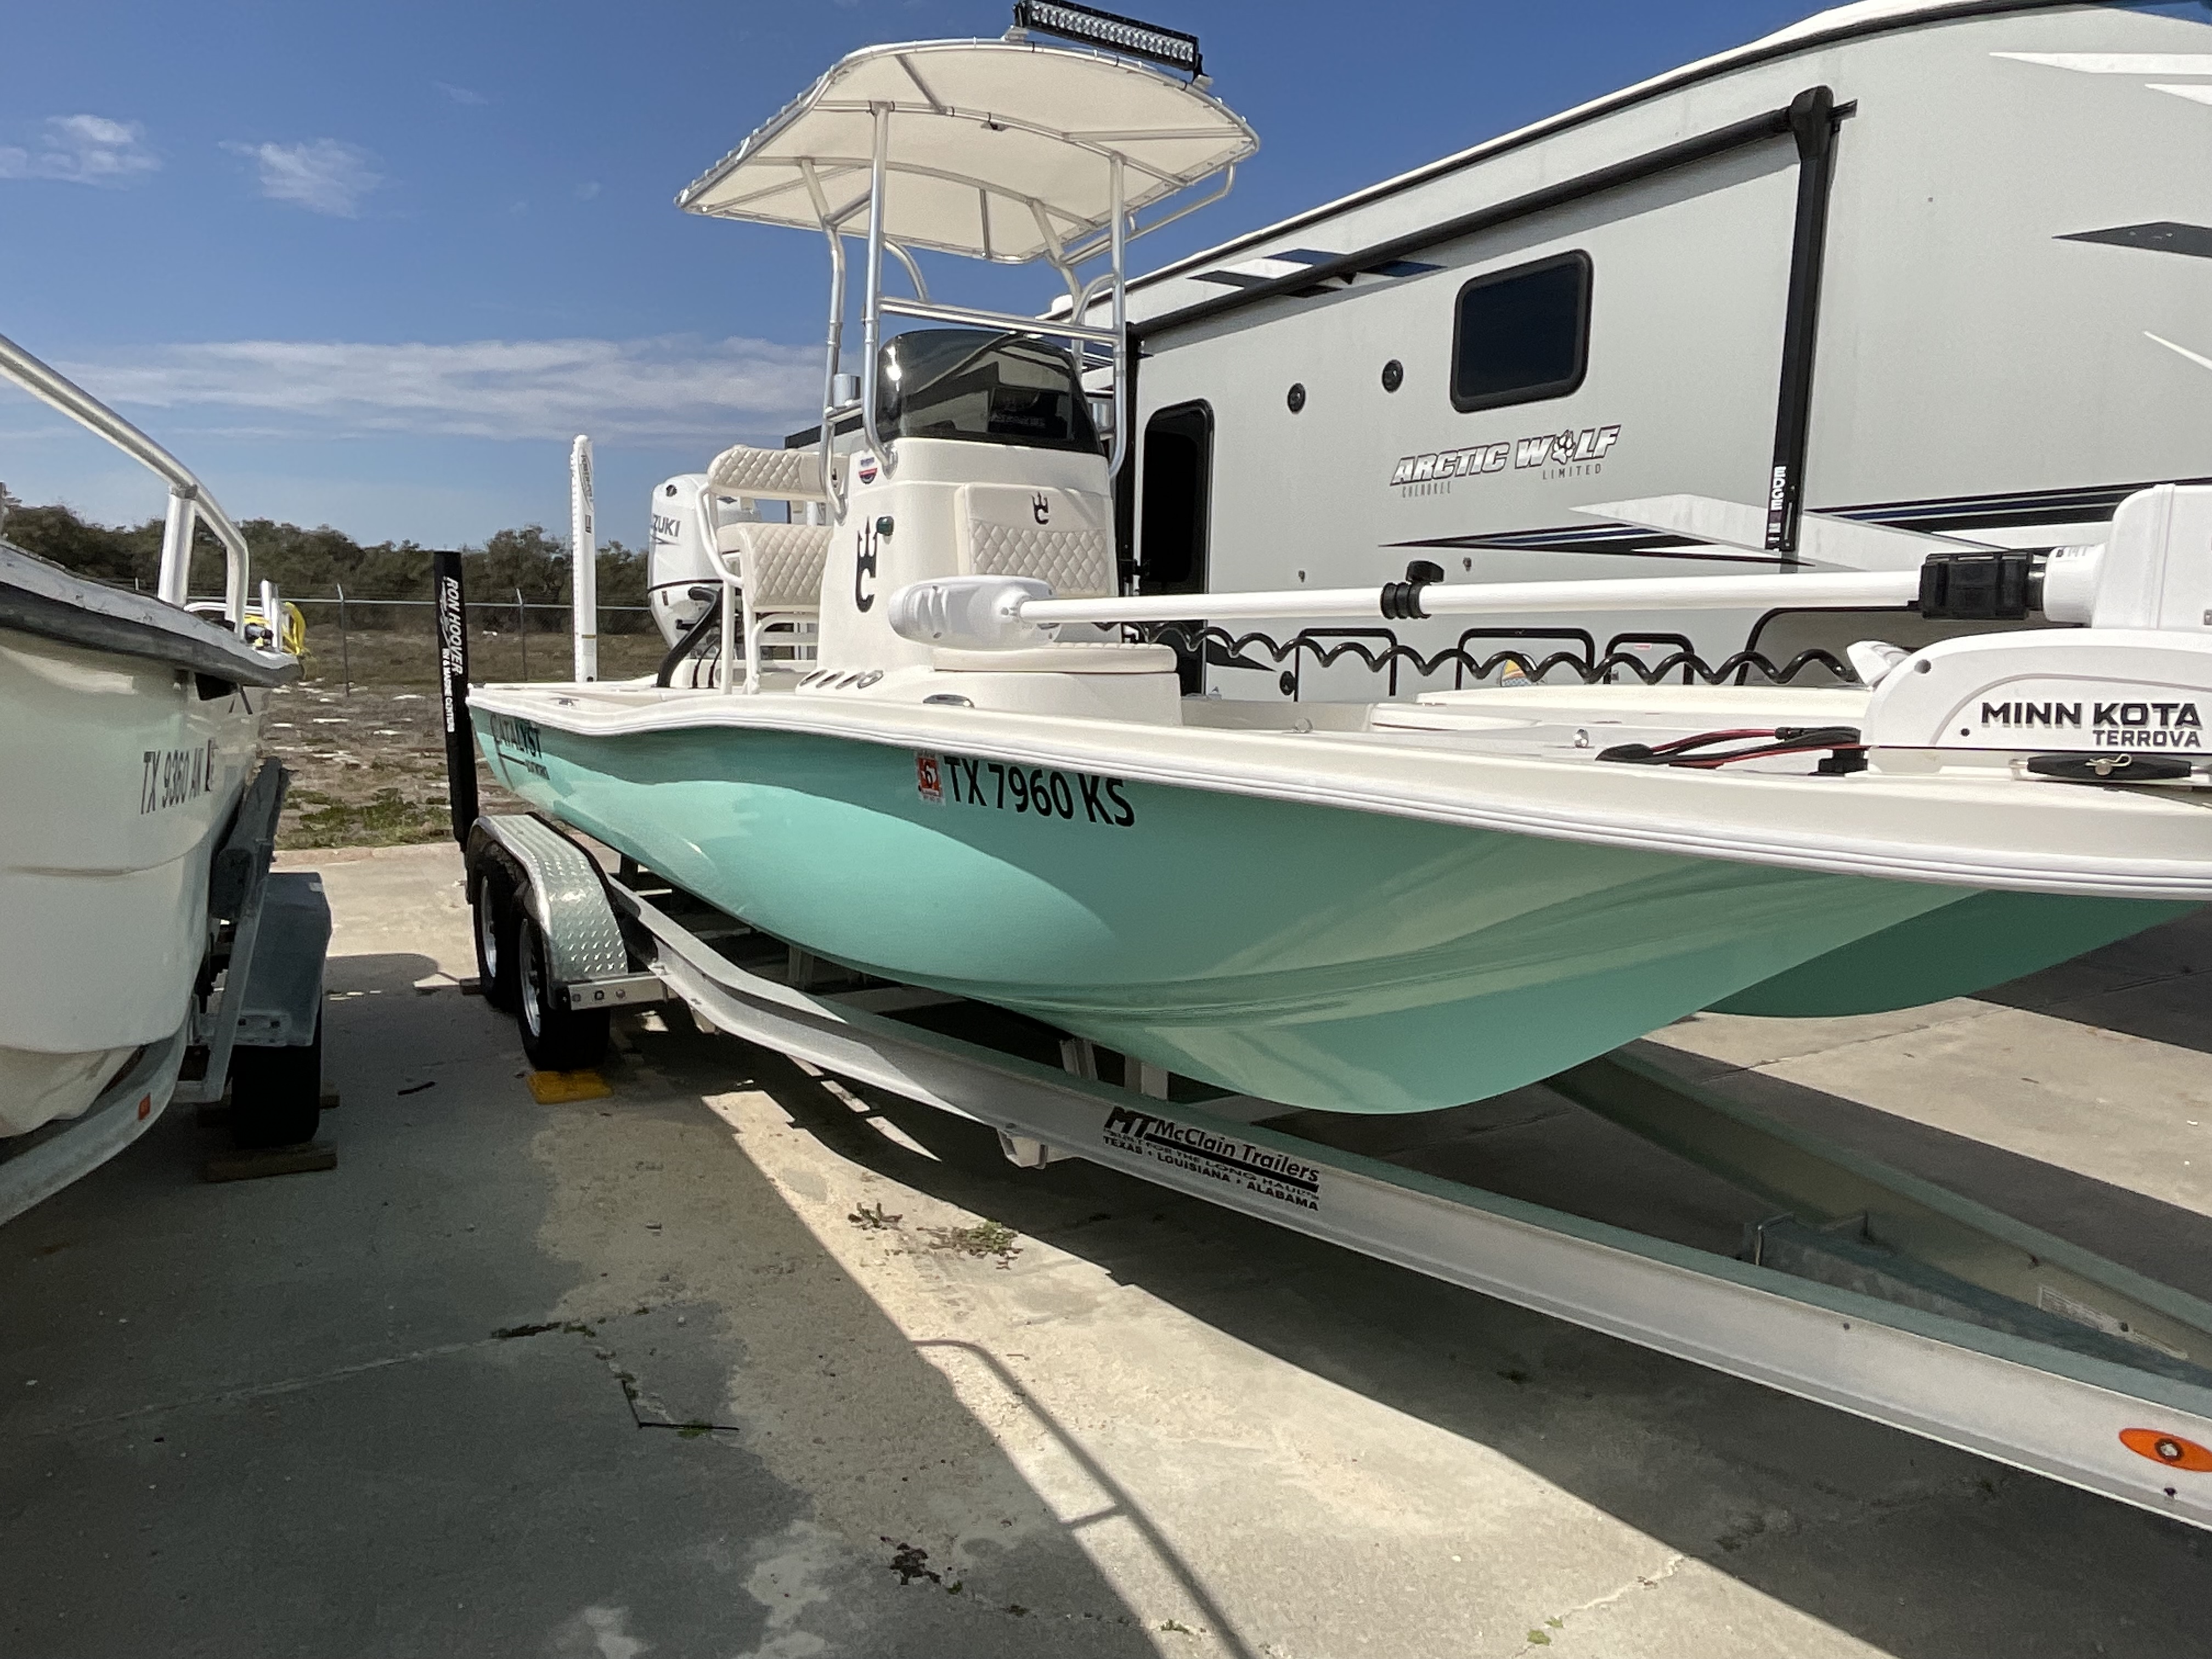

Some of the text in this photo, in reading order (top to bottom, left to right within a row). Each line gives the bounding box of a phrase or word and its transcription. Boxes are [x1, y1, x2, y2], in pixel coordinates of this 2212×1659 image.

[1390, 442, 1510, 486] ARCTIC
[1542, 462, 1601, 479] LIMITED
[1771, 466, 1787, 510] EDGE
[653, 514, 681, 537] ZUKI
[443, 576, 464, 675] RON HOOVER
[1981, 702, 2203, 730] MINN KOTA
[2092, 730, 2202, 747] TERROVA
[141, 749, 161, 815] TX
[944, 755, 988, 806] TX
[988, 763, 1074, 820] 7960
[1077, 772, 1135, 827] KS
[1154, 1119, 1320, 1182] McClain Trailers
[1156, 1152, 1231, 1182] LOUISIANA
[1246, 1181, 1319, 1211] ALABAMA
